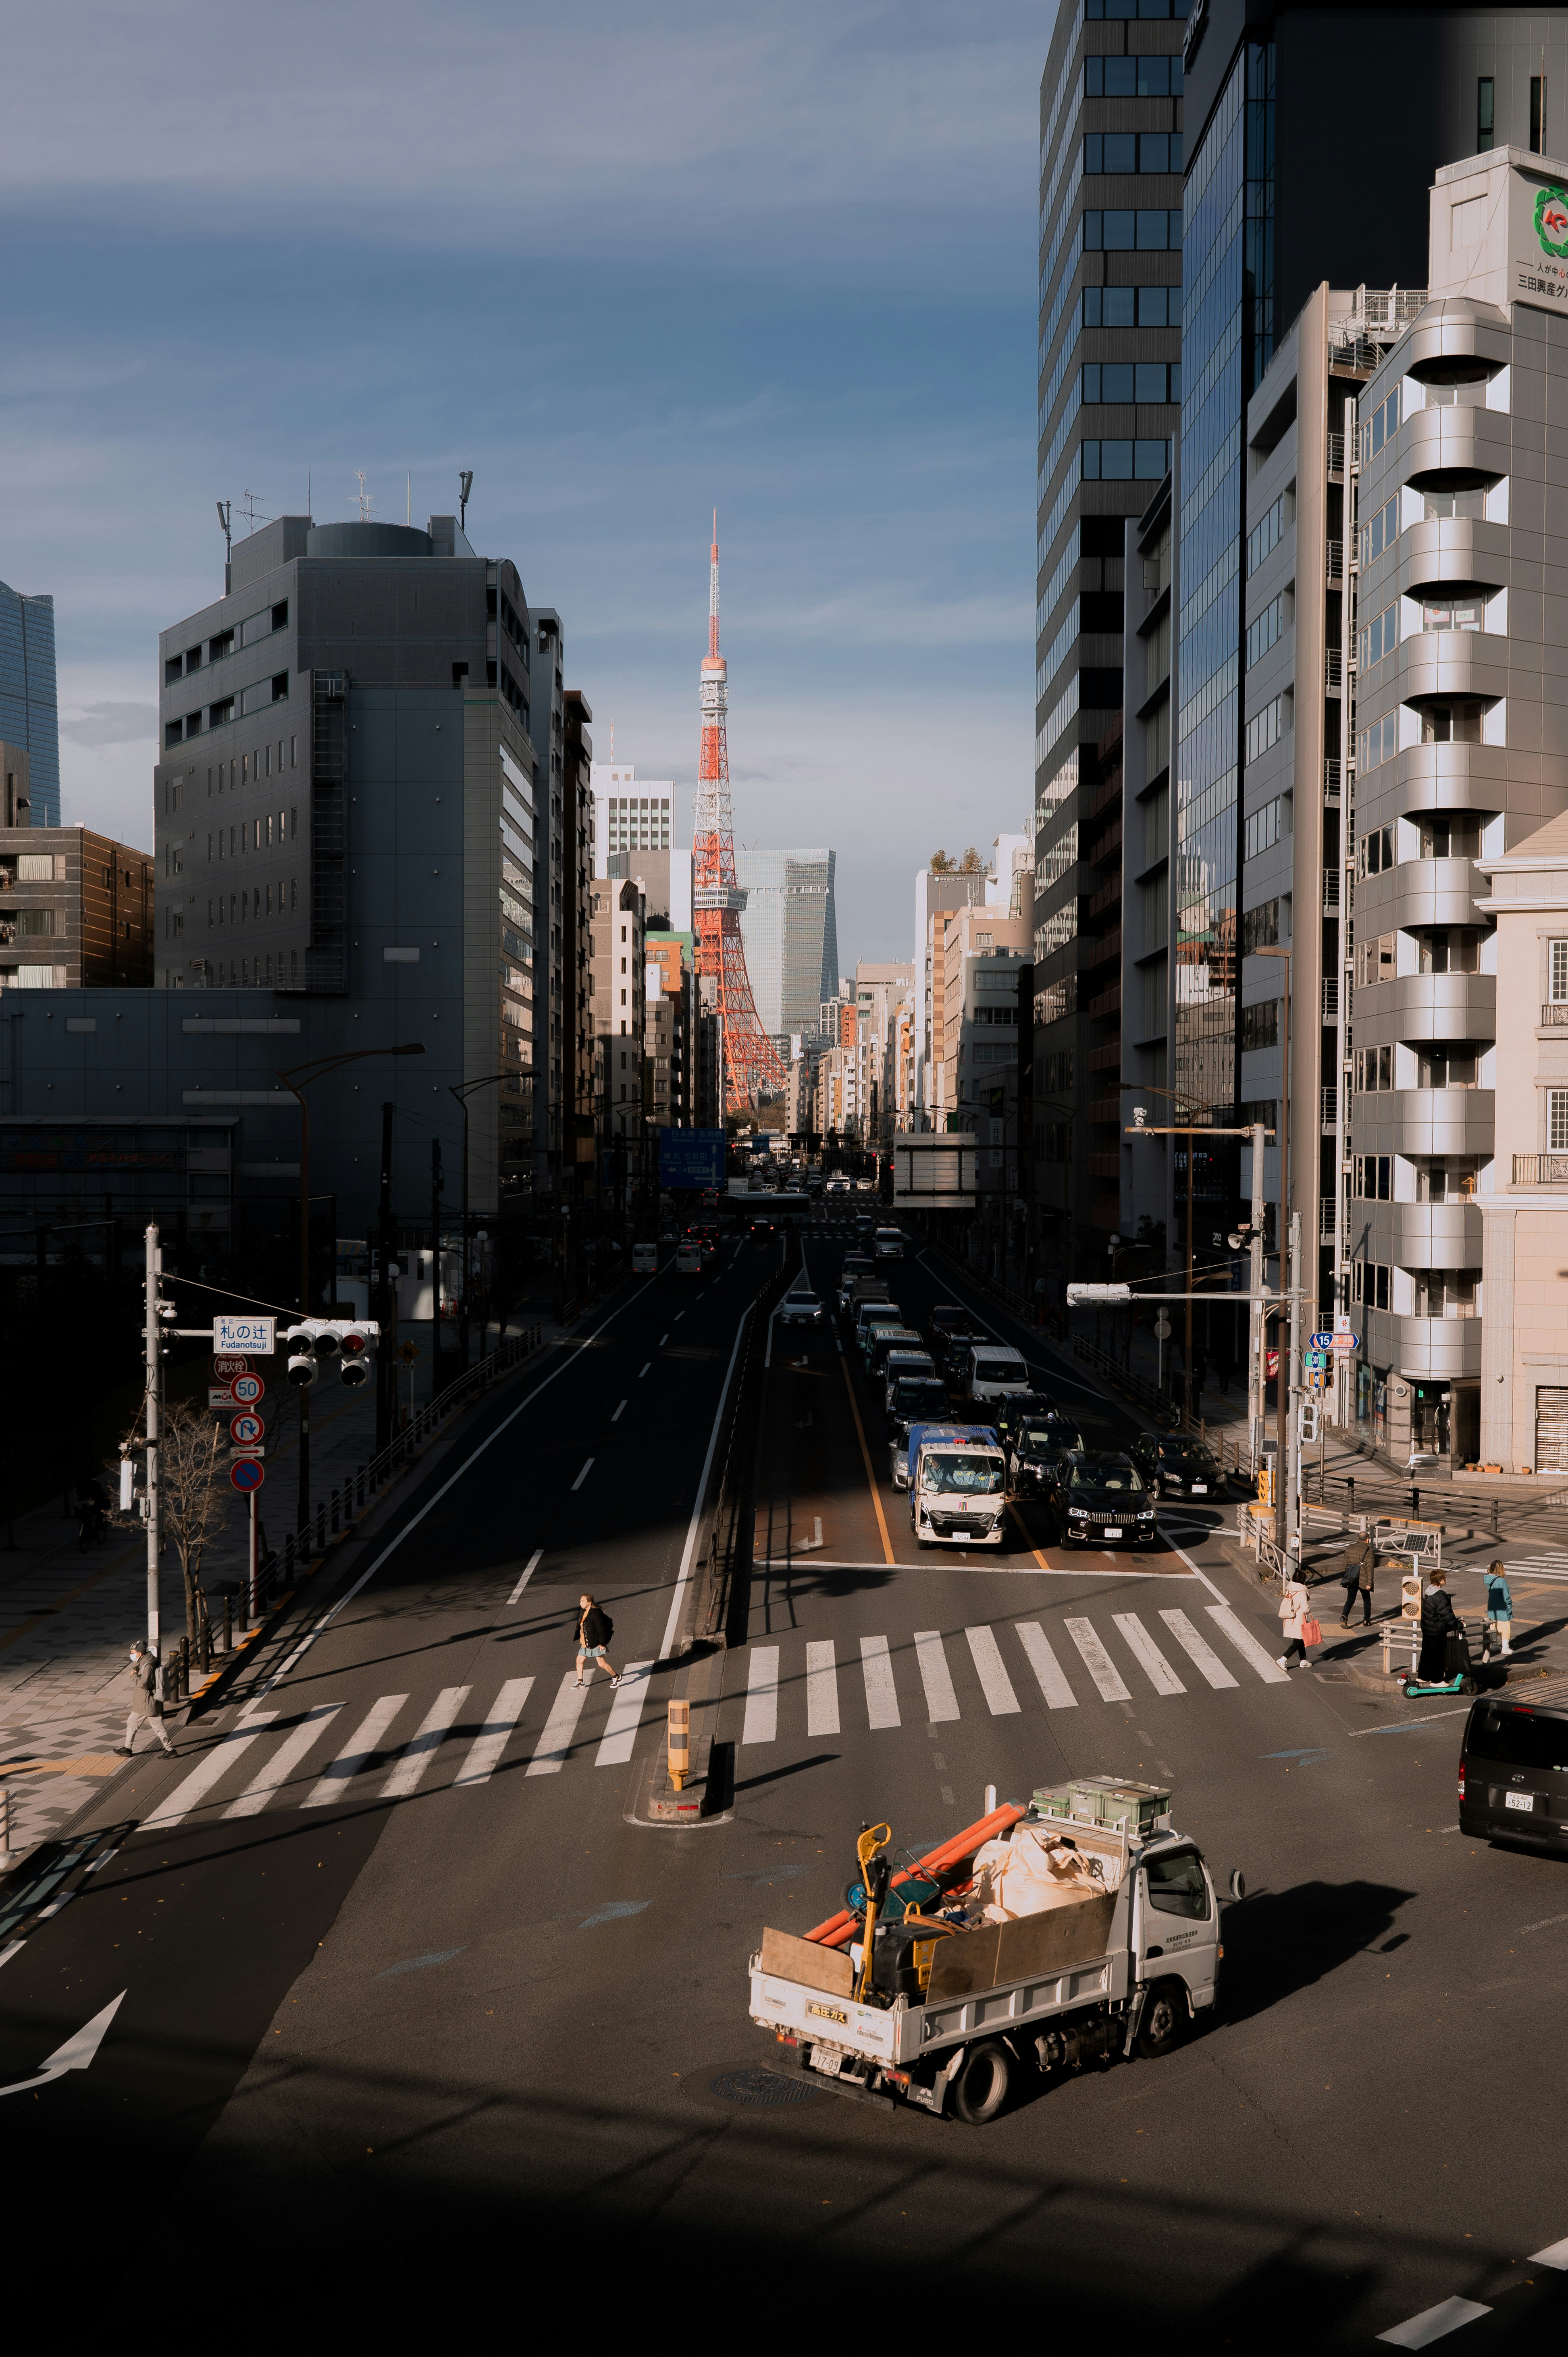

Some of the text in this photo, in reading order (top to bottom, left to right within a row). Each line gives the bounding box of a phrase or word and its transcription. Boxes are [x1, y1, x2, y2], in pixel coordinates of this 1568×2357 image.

[699, 1130, 722, 1138] 赤羽橋
[7, 1136, 43, 1148] 安全
[220, 1325, 267, 1339] 札の辻
[222, 1341, 266, 1350] Fudanotsuji
[1319, 1336, 1329, 1345] 15
[218, 1361, 244, 1373] 消火栓
[239, 1382, 256, 1396] 50
[1512, 1799, 1531, 1810] 52-12
[811, 2003, 845, 2023] 高圧ガス
[817, 2055, 838, 2071] 17-09
[916, 2095, 934, 2105] FUSO
